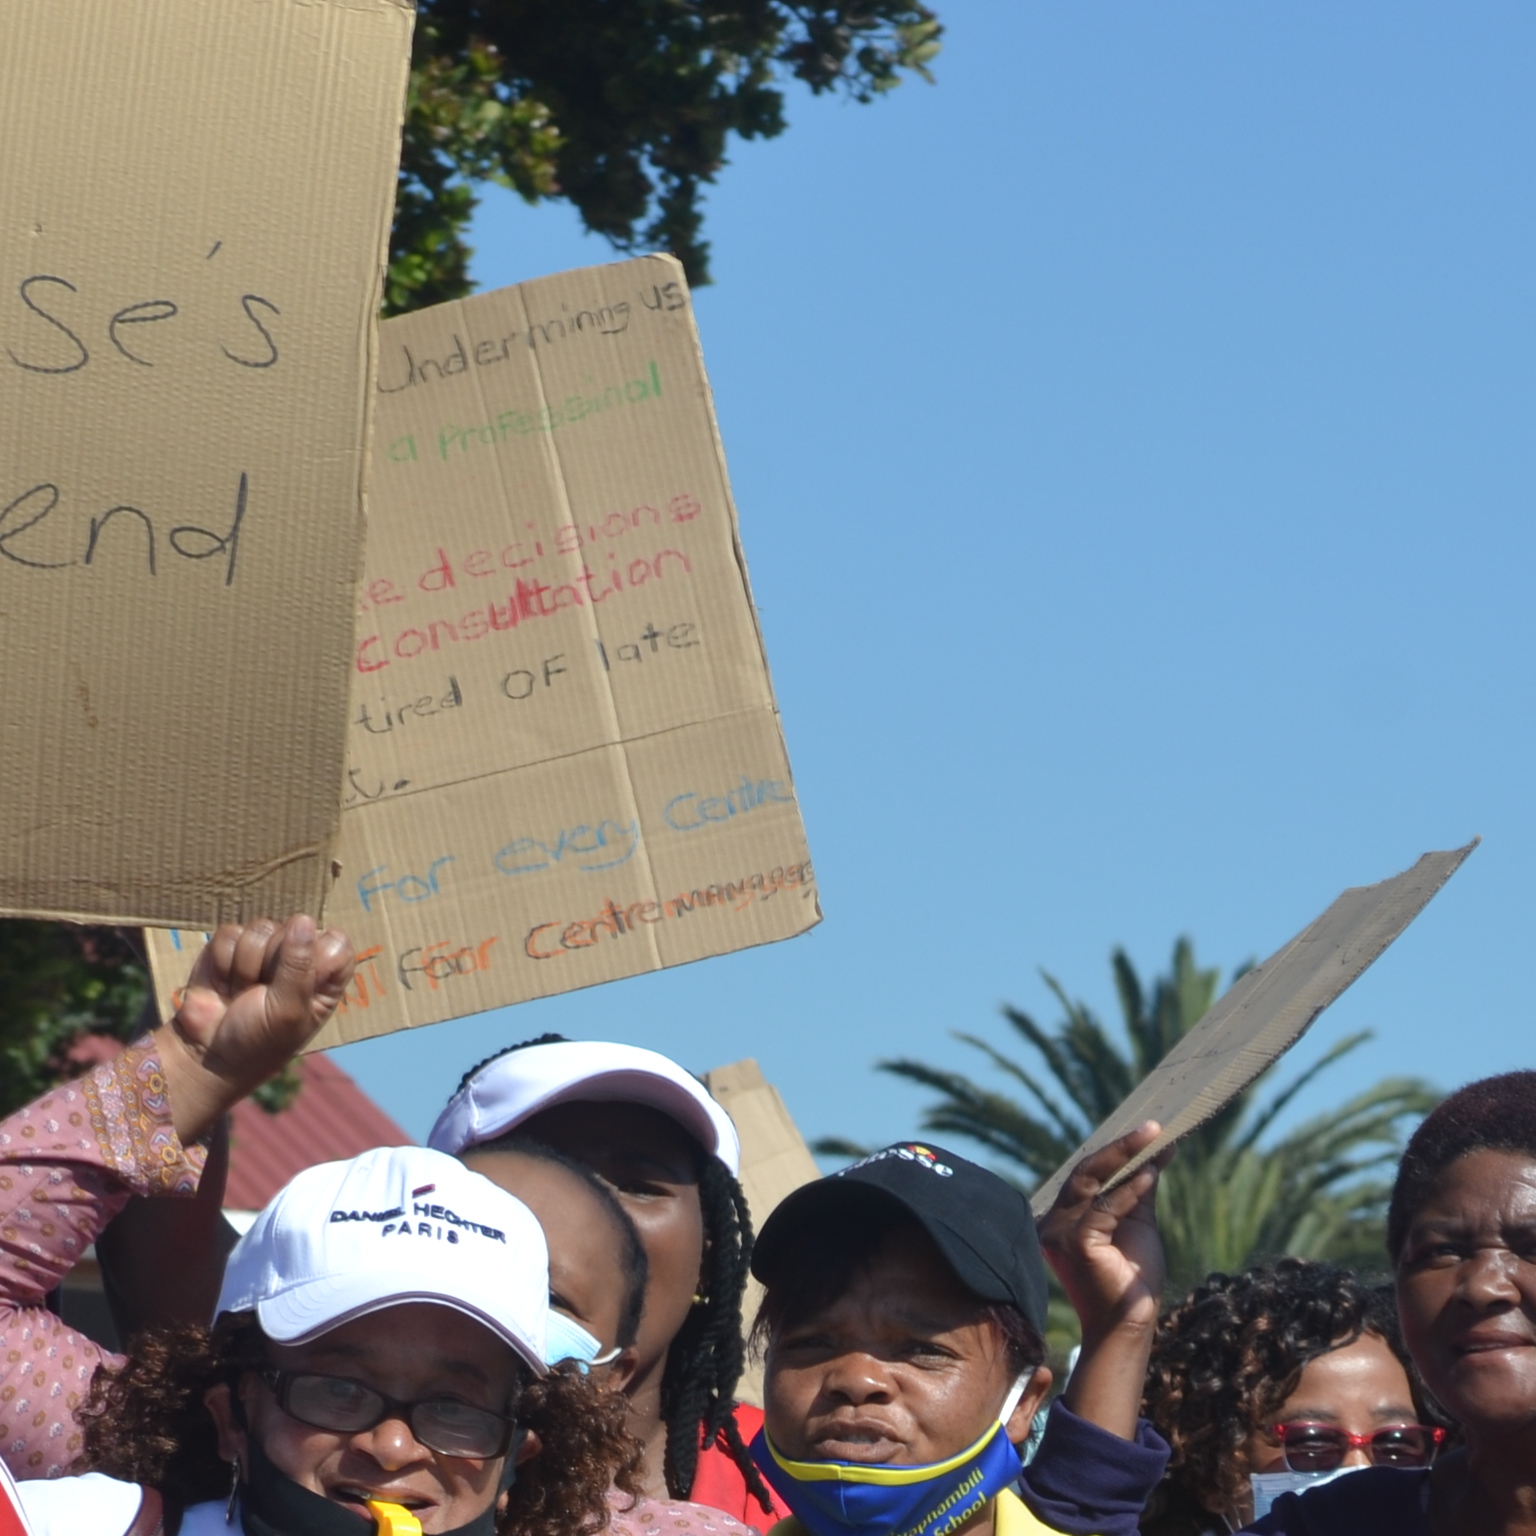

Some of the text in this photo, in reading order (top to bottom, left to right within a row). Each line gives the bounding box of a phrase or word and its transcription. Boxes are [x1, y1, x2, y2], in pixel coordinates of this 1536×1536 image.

[418, 493, 702, 592] decisions
[493, 818, 641, 876] every
[381, 1220, 460, 1245] PARIS
